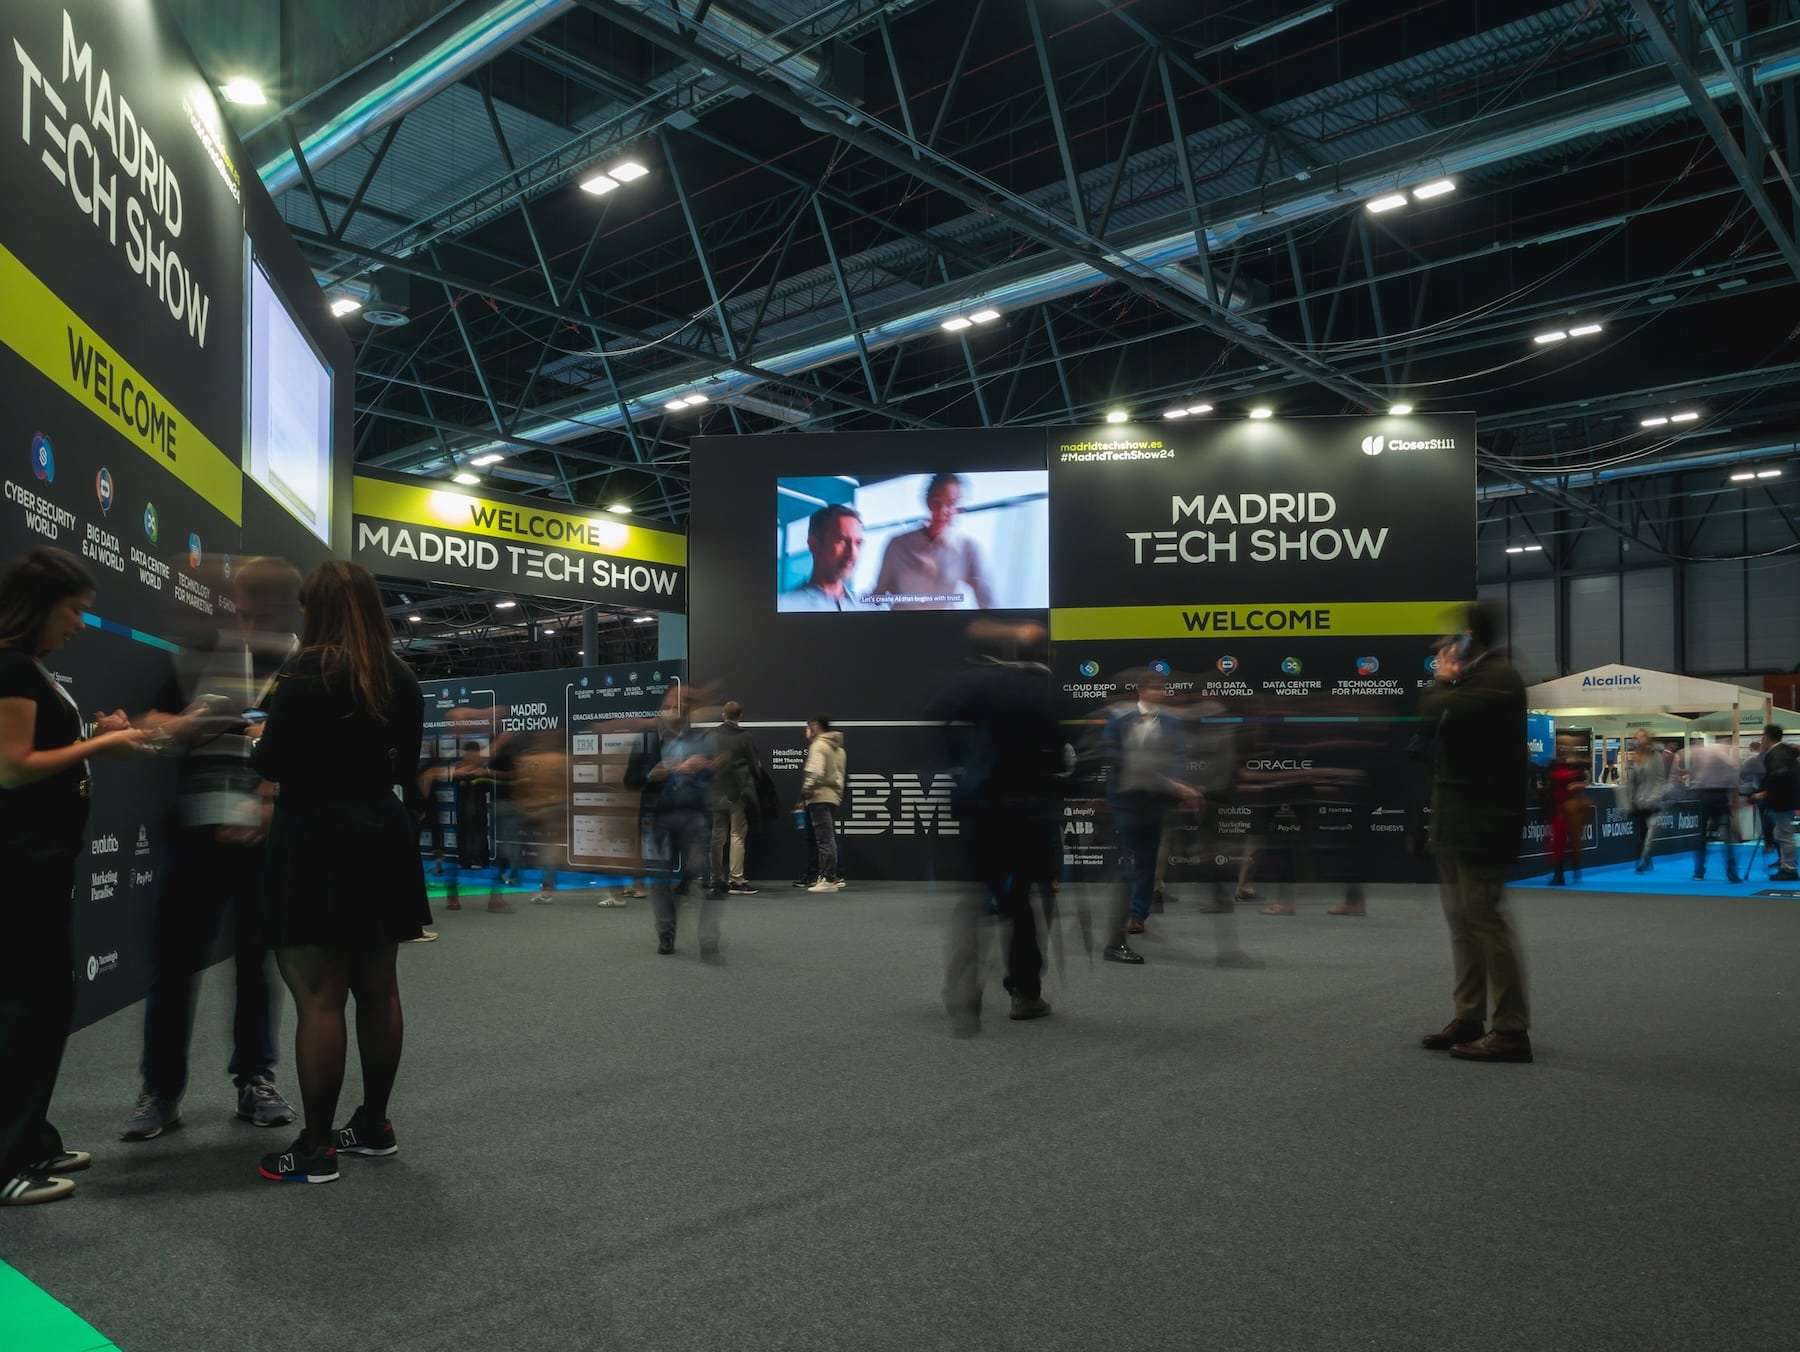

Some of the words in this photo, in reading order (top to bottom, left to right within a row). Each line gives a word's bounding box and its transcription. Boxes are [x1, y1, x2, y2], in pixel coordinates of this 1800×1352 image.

[63, 8, 182, 238] MADRID
[13, 37, 117, 247] TECH
[126, 196, 209, 349] SHOW
[67, 325, 177, 462] WELCOME
[1060, 441, 1163, 452] madridtechshow.es
[1389, 438, 1456, 451] CloserStill
[1060, 449, 1175, 462] #MadridTechShow24
[4, 480, 35, 509] CYBER
[36, 496, 76, 531] SECURITY
[1172, 492, 1337, 526] MADRID
[25, 509, 58, 540] WORLD
[470, 504, 600, 547] WELCOME
[87, 522, 100, 544] BIG
[101, 530, 120, 554] DATA
[1125, 530, 1237, 564] TECH
[1250, 527, 1390, 563] SHOW
[82, 539, 89, 556] &
[89, 543, 98, 561] AI
[98, 548, 125, 573] WORLD
[131, 546, 147, 567] DATA
[148, 555, 170, 579] CENTRE
[359, 523, 499, 571] MADRID
[505, 545, 584, 584] TECH
[592, 561, 678, 596] SHOW
[140, 568, 162, 590] WORLD
[178, 572, 211, 600] TECHNOLOGY
[175, 586, 185, 602] FOR
[185, 591, 214, 616] MARKETING
[1182, 609, 1331, 632] WELCOME
[1063, 683, 1093, 692] CLOUD
[1093, 683, 1116, 692] EXPO
[1162, 682, 1194, 690] CURITY
[1262, 681, 1286, 689] DATA
[1337, 680, 1399, 688] TECHNOLOGY
[1582, 674, 1641, 687] Alcalink
[1073, 691, 1107, 699] EUROPE
[1221, 688, 1254, 696] WORLD
[1275, 688, 1308, 696] WORLD
[1352, 687, 1404, 695] MARKETING
[511, 703, 547, 716] MADRID
[502, 718, 525, 732] TECH
[526, 716, 558, 730] SHOW
[772, 748, 803, 756] Headline
[1246, 759, 1312, 770] ORACLE
[835, 773, 960, 835] BM
[1073, 808, 1095, 817] shopify
[1063, 821, 1094, 834] ABB
[1602, 824, 1611, 837] VIP
[1612, 822, 1633, 836] LOUNGE
